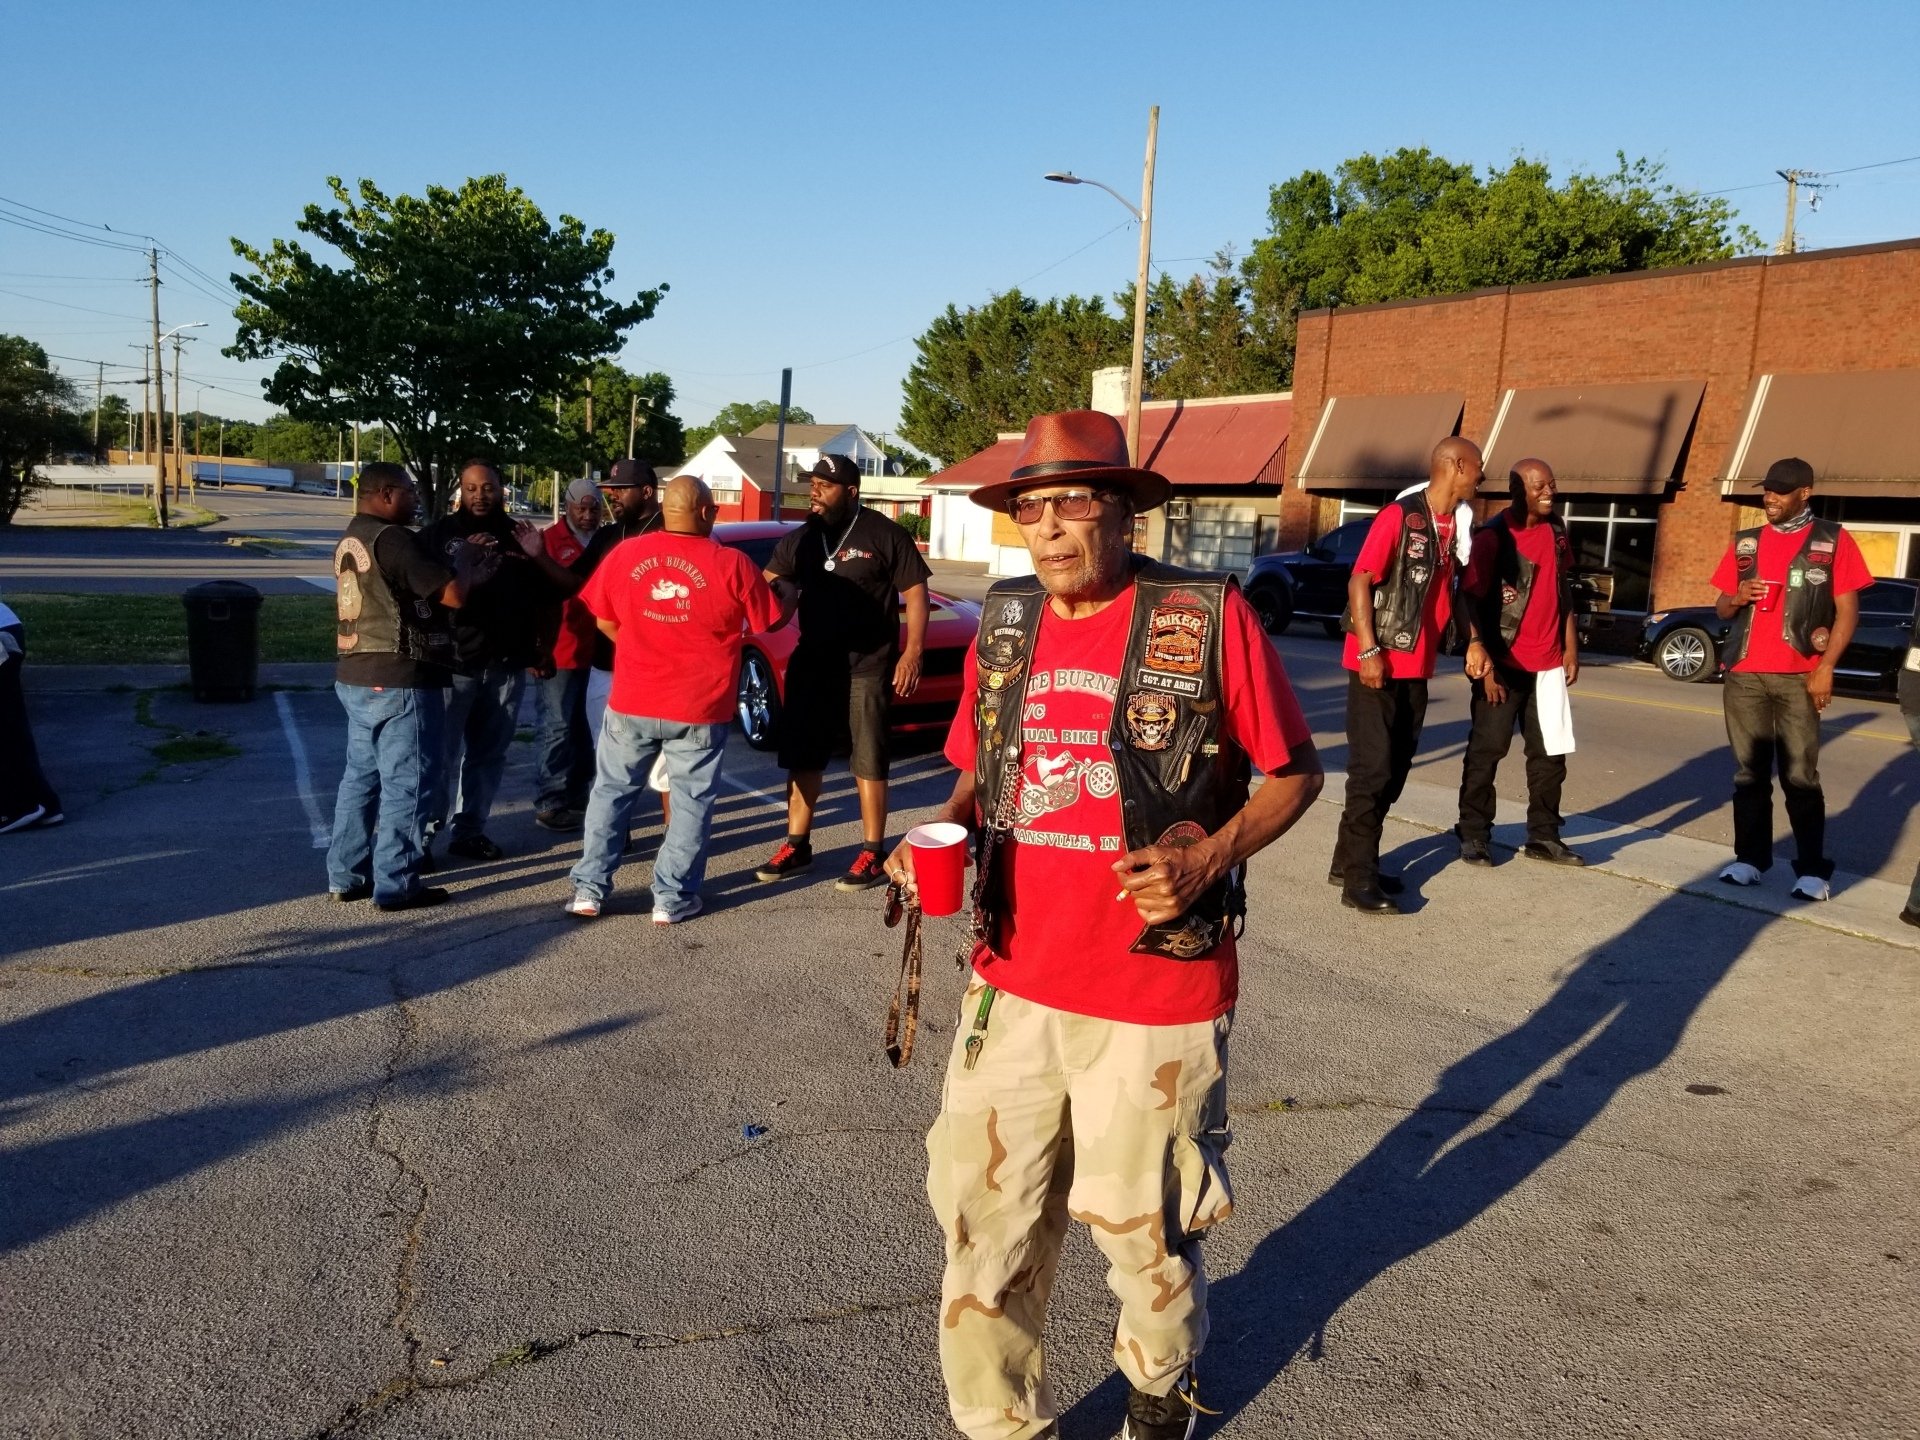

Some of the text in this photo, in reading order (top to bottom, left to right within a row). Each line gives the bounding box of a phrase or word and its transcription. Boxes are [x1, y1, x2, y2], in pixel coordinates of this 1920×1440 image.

[631, 557, 659, 581] STATE
[1155, 613, 1201, 632] BIKER
[994, 627, 1016, 637] VIETNAM
[1142, 674, 1196, 692] SGT. AT ARMS
[1130, 693, 1175, 711] SOUTHERN
[1061, 729, 1098, 745] BIKE
[1099, 836, 1120, 851] IN
